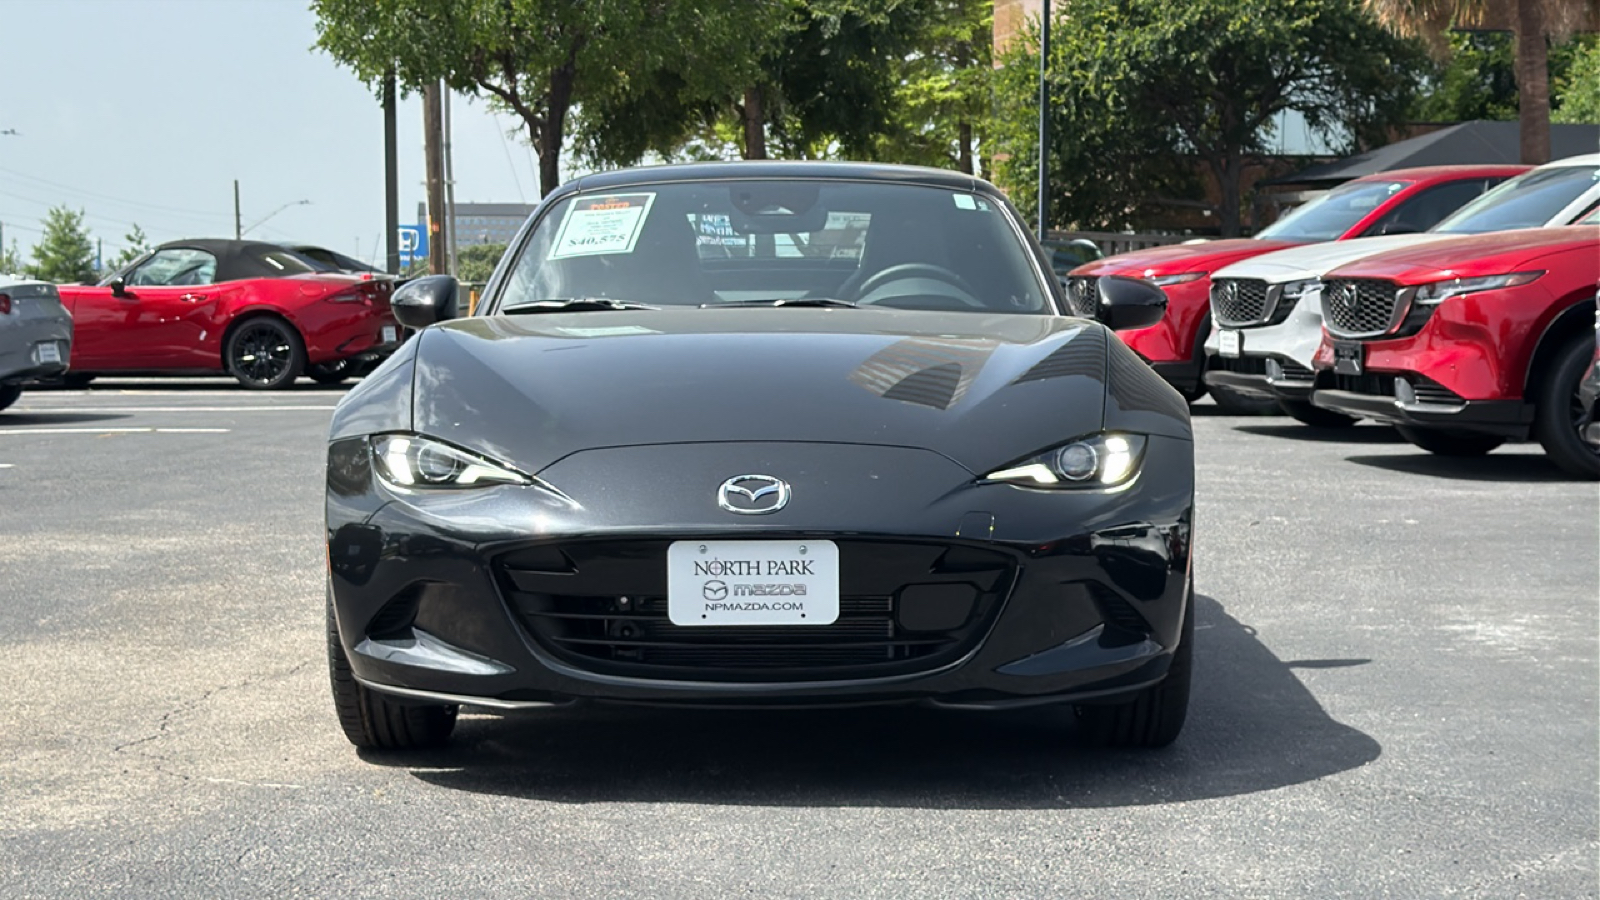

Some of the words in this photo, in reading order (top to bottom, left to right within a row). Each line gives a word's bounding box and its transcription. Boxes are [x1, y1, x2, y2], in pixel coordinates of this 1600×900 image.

[568, 233, 627, 247] $40,575
[693, 558, 762, 577] NORTH
[766, 559, 815, 576] PARK
[733, 583, 807, 597] mazda
[705, 601, 804, 611] NPMAZDA.COM
